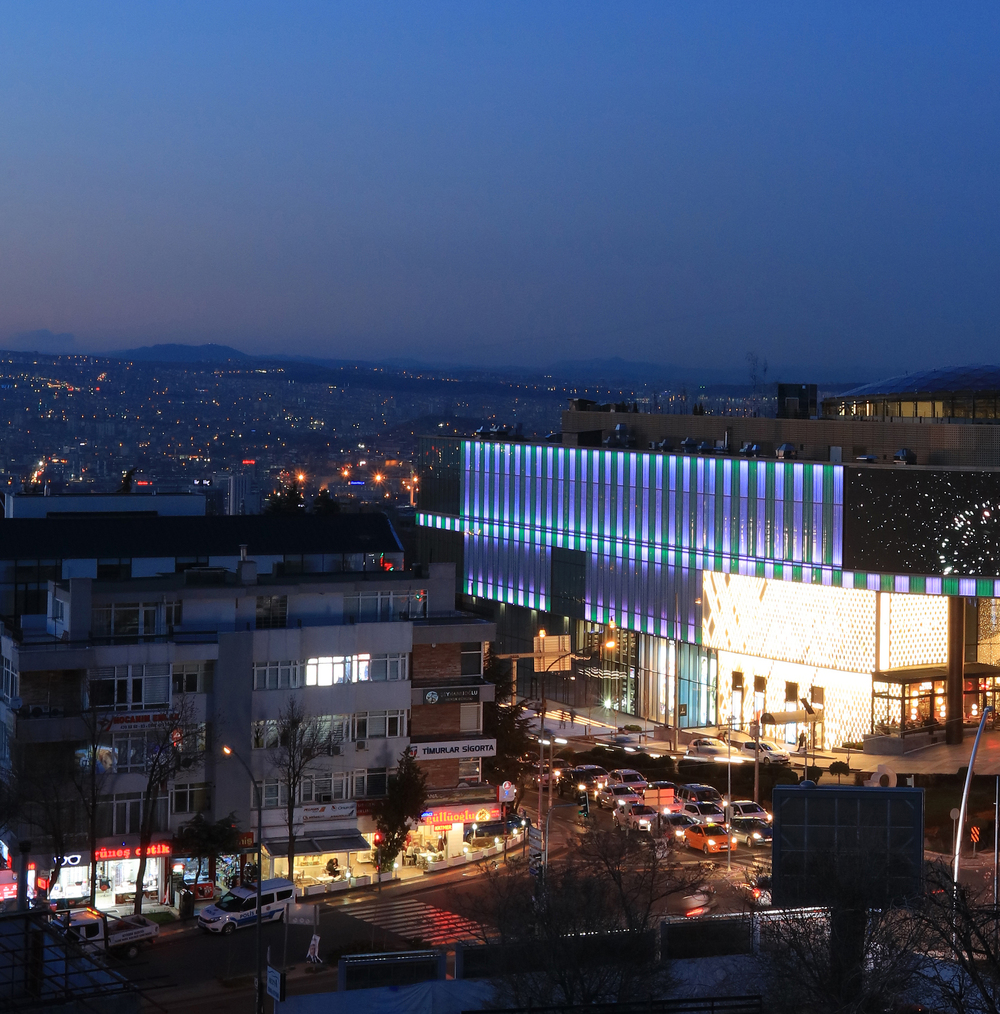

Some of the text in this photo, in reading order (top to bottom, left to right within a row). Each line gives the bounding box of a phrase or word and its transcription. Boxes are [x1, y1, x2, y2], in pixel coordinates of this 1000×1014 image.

[423, 744, 494, 754] TİMURLAR SİGORTA
[426, 809, 475, 825] güllüoğlu
[239, 837, 253, 845] nis
